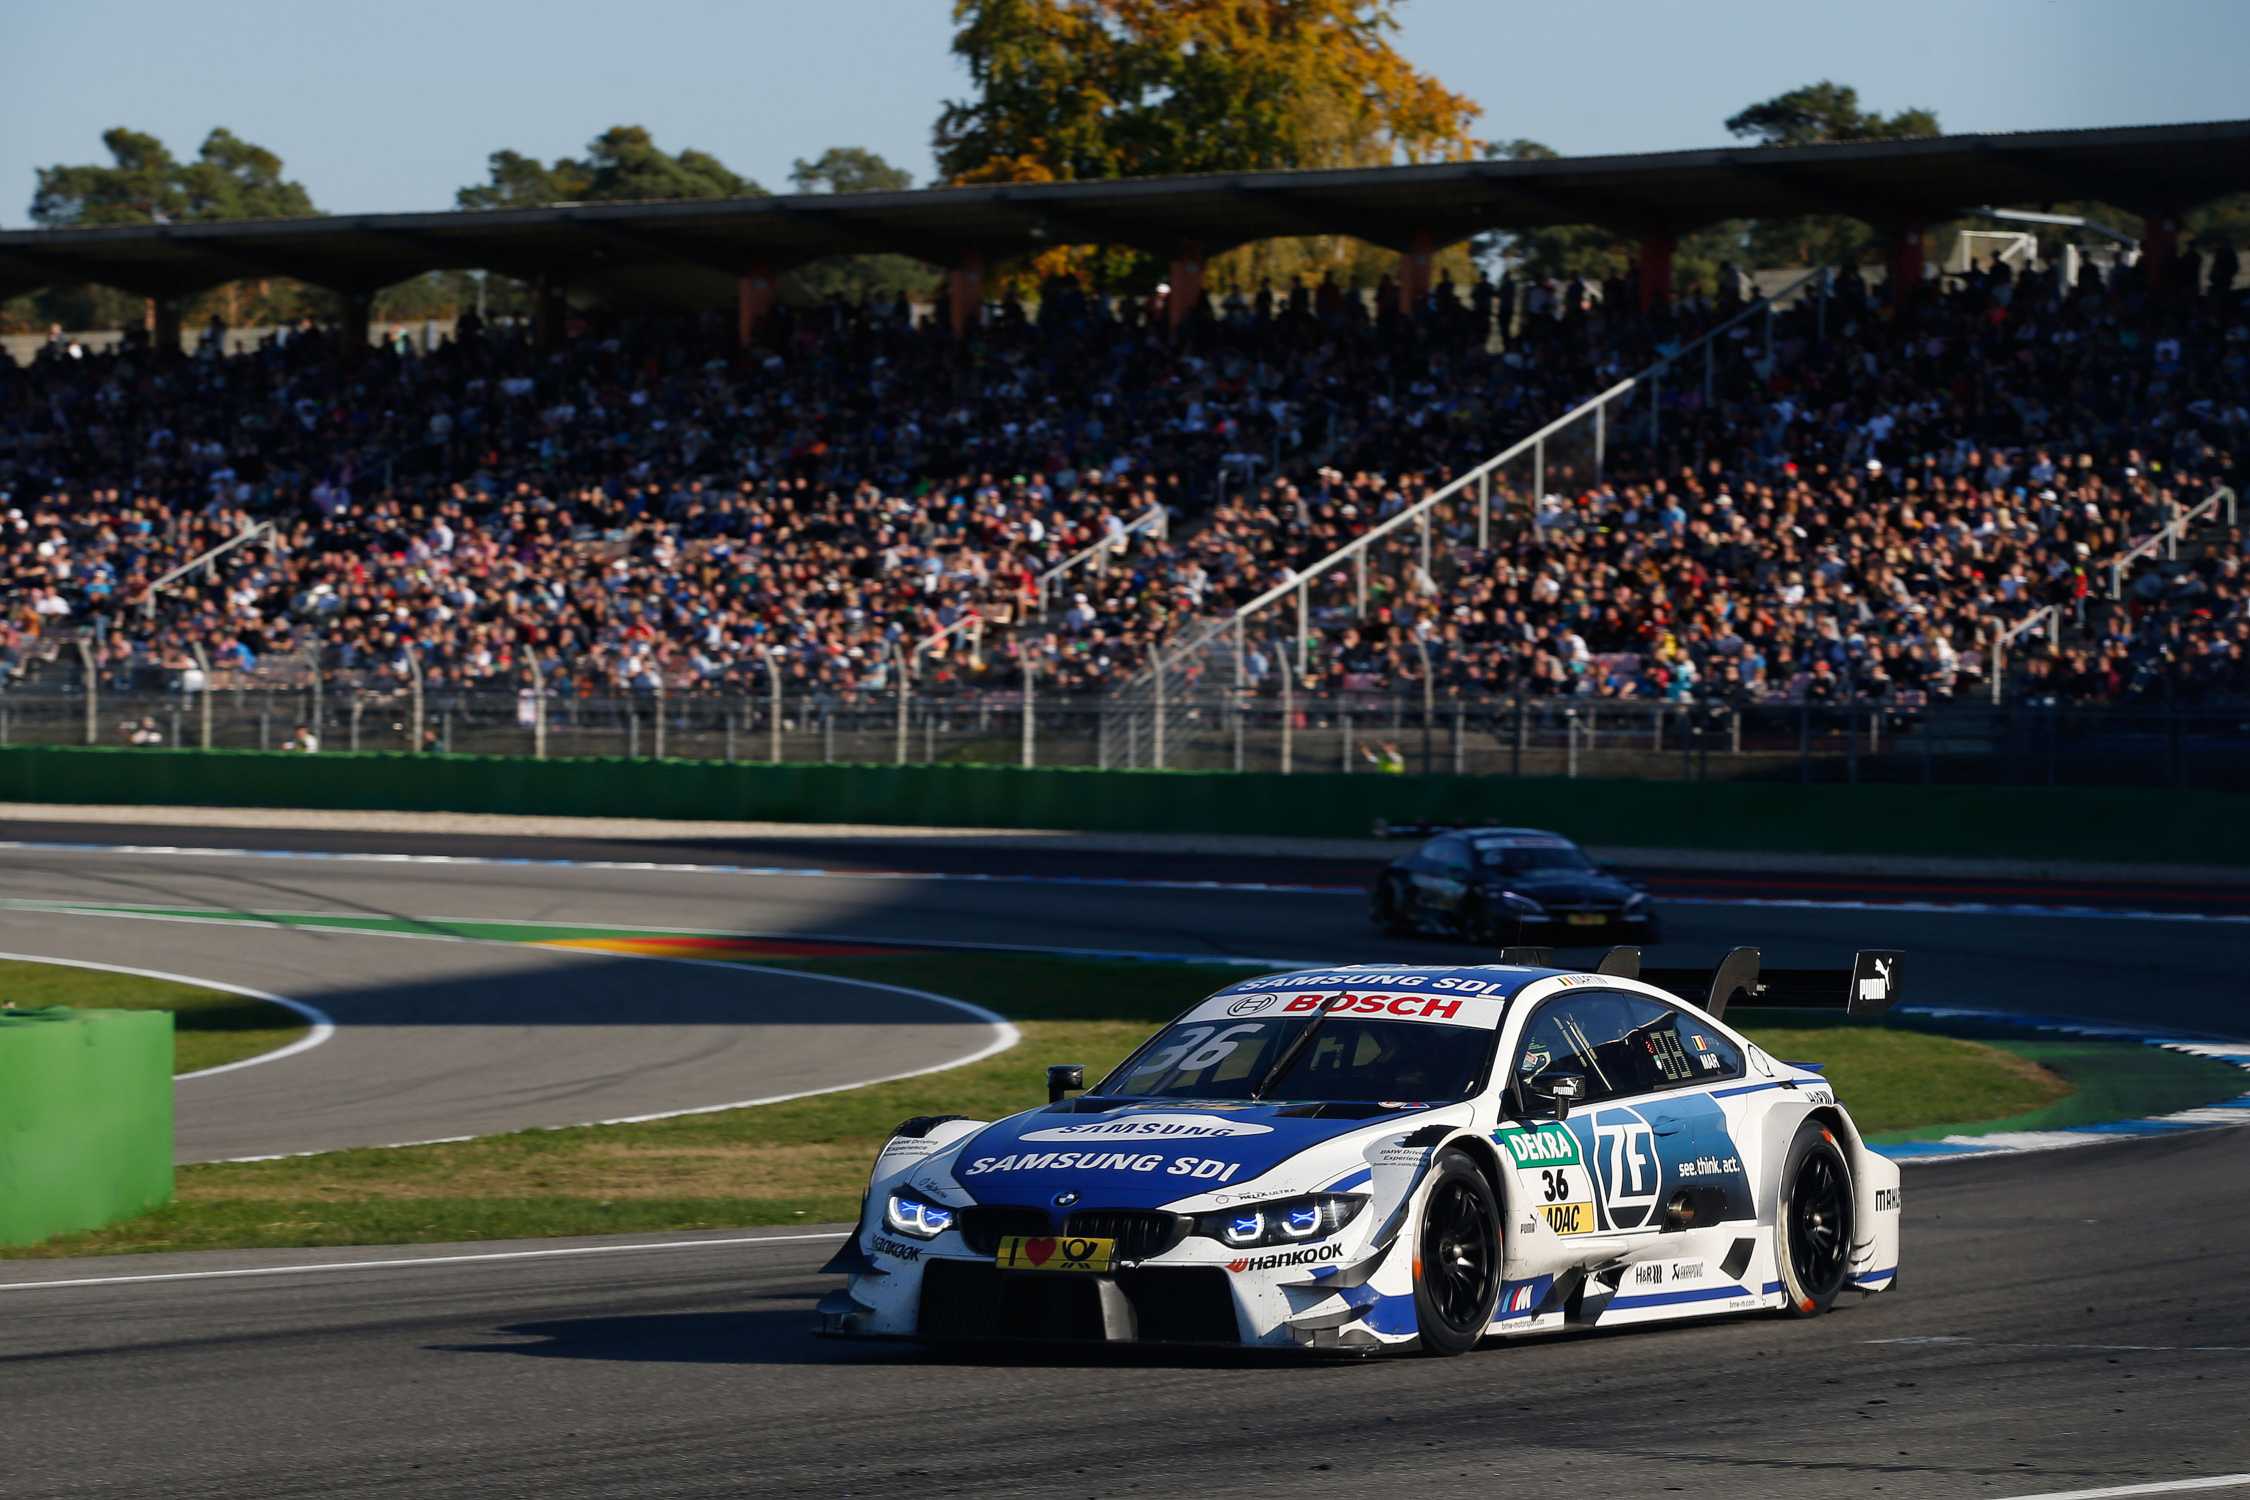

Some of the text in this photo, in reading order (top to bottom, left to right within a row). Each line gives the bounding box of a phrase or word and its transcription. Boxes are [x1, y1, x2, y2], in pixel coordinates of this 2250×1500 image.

[1237, 974, 1504, 995] SAMSUNG SDI
[1859, 978, 1886, 1000] PUMA
[1282, 994, 1464, 1019] BOSCH
[1132, 1022, 1266, 1076] 36
[1700, 1053, 1720, 1070] MAR
[1553, 1086, 1575, 1096] PUMA
[1058, 1121, 1235, 1138] SAMSUNG
[1508, 1130, 1573, 1162] DEKRA
[964, 1151, 1242, 1183] SAMSUNG SDI
[1595, 1121, 1658, 1209] ZF
[1723, 1156, 1741, 1174] act.
[1541, 1168, 1570, 1203] 36
